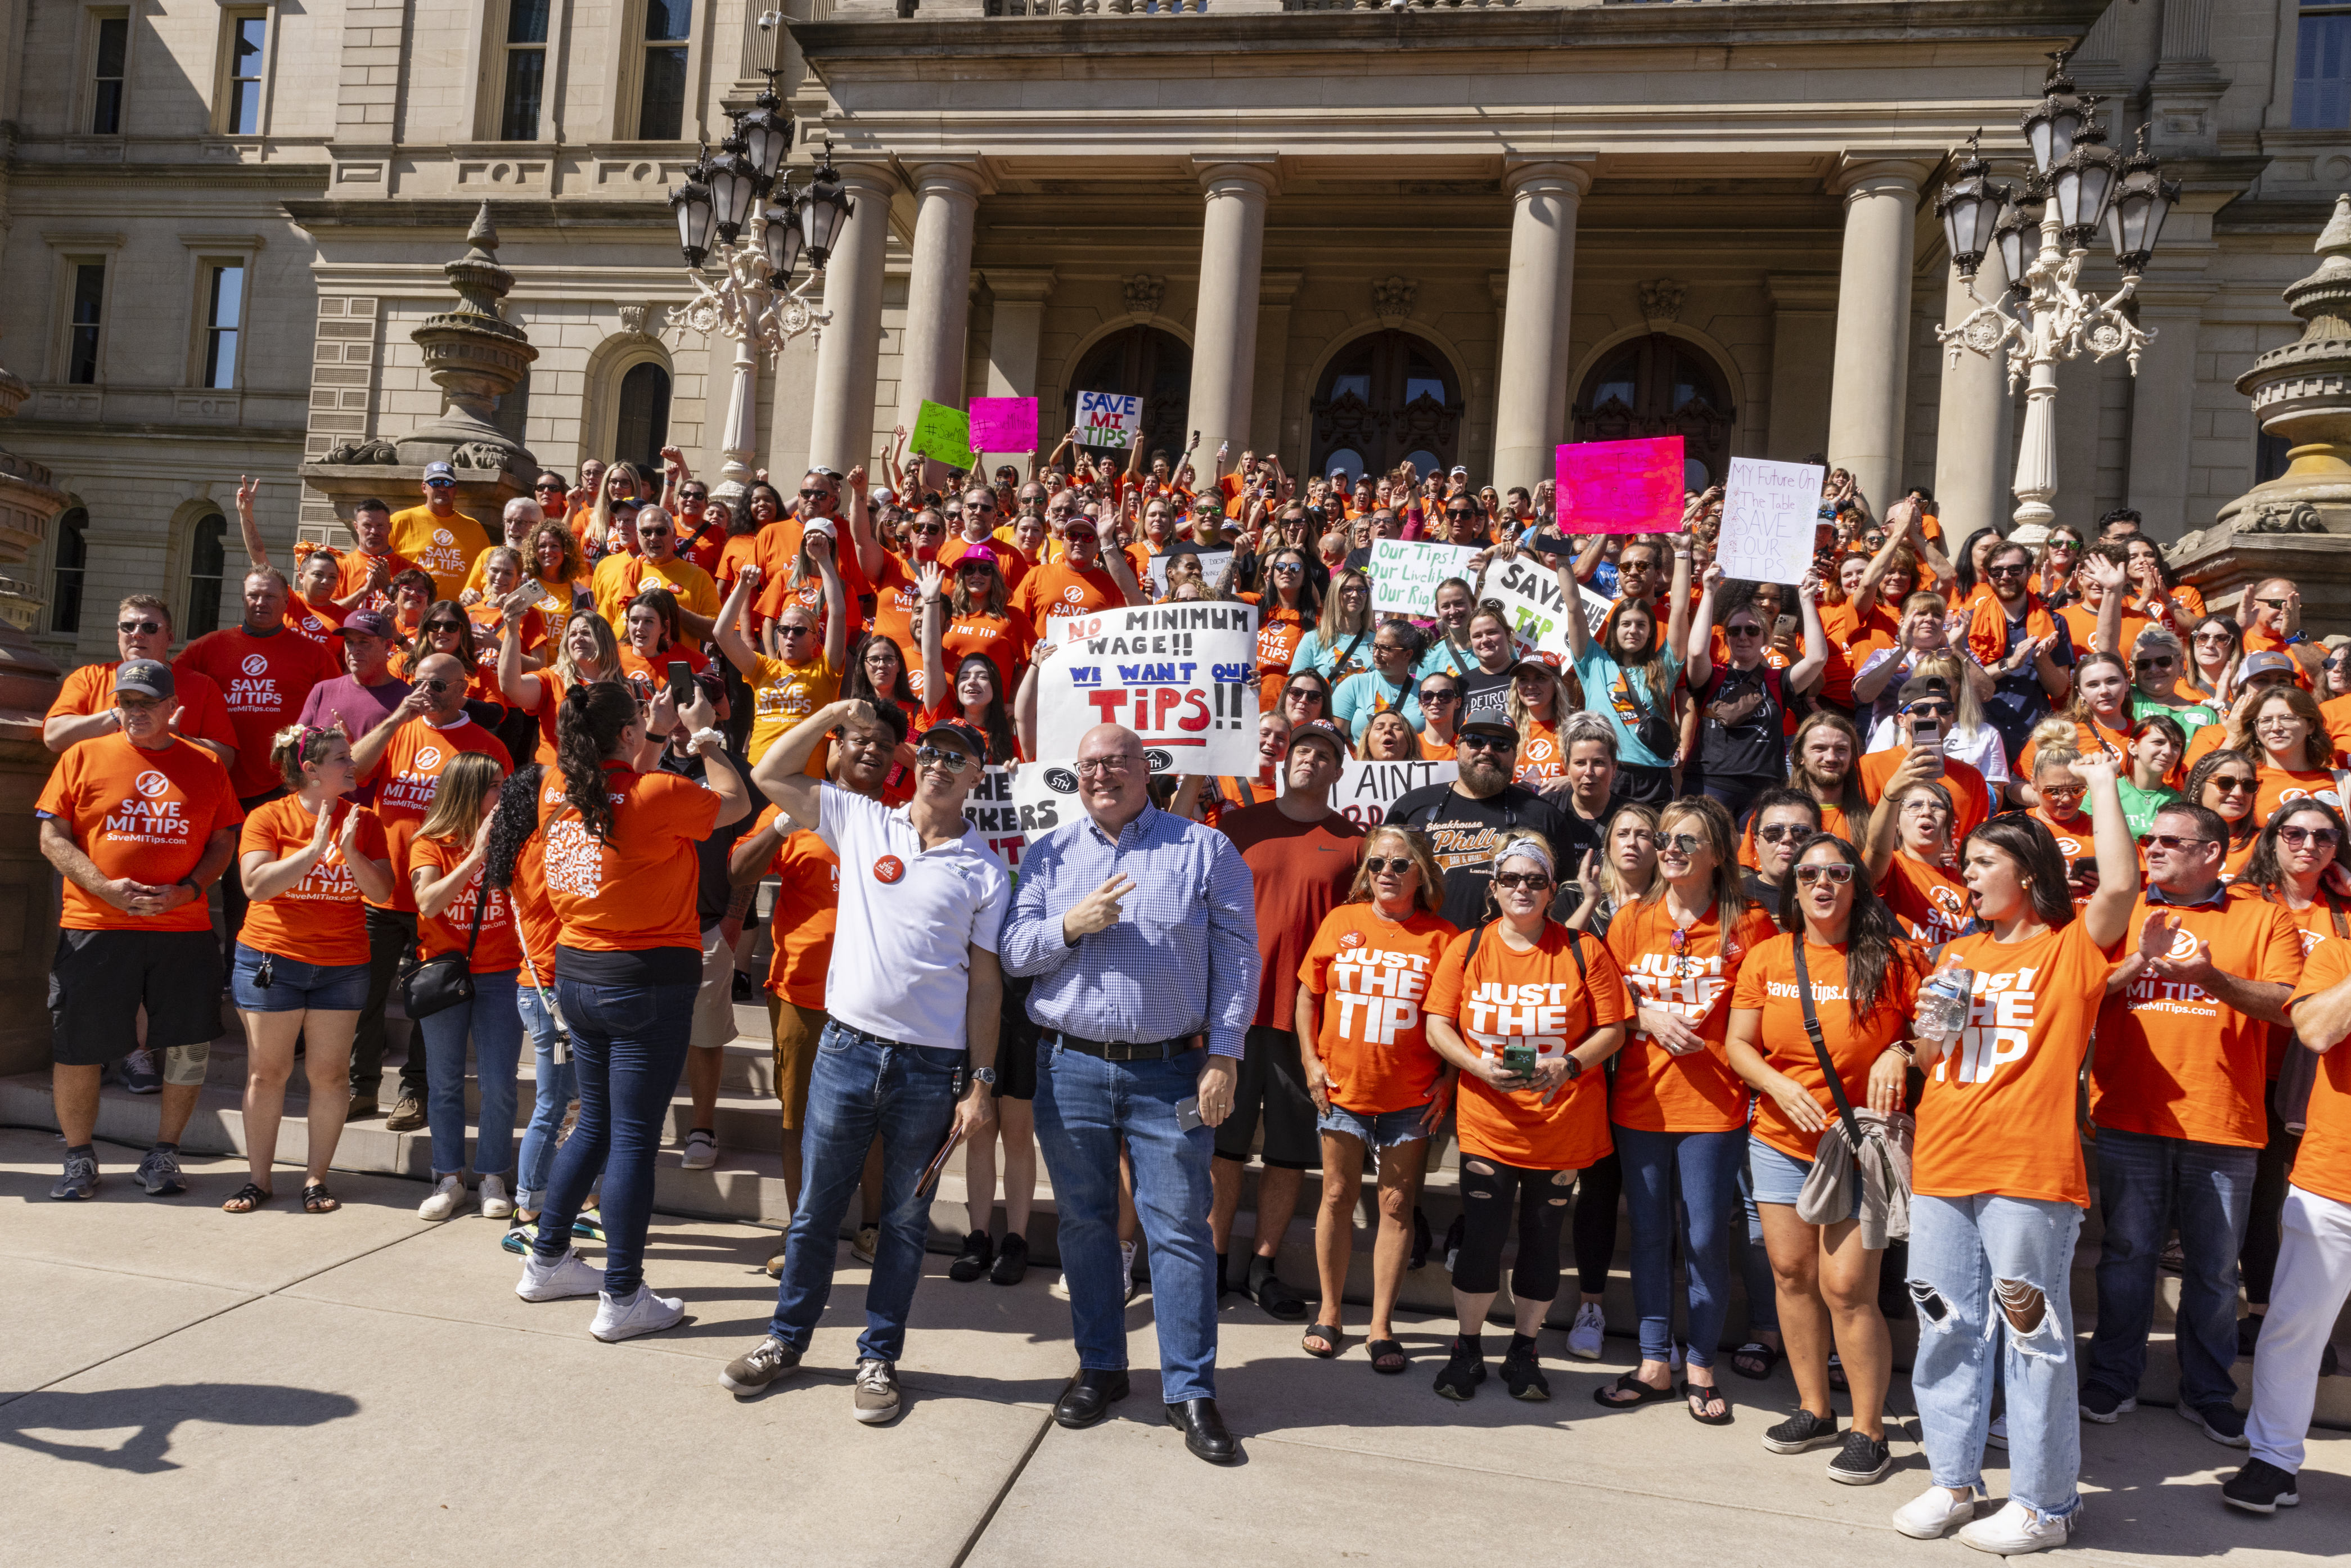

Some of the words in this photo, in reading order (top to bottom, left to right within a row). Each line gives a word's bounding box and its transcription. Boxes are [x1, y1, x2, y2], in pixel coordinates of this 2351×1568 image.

[1082, 392, 1136, 415] SAVE
[1090, 412, 1123, 429] MI
[1084, 426, 1129, 448] TIPS
[1758, 466, 1795, 488] Future
[1740, 491, 1765, 509] The
[1769, 493, 1795, 510] Table
[1735, 507, 1792, 538] SAVE
[425, 546, 461, 561] SAVE
[1379, 542, 1409, 560] Our
[1413, 544, 1458, 568] Tips!
[1744, 536, 1781, 556] OUR
[418, 557, 434, 569] MI
[438, 558, 466, 572] TIPS
[1367, 561, 1399, 580] Our
[1731, 555, 1786, 580] TIPS
[1379, 583, 1406, 602] Our
[1501, 564, 1565, 614] SAVE
[1053, 602, 1089, 616] SAVE
[1069, 618, 1101, 641] NO
[1126, 609, 1249, 632] MINIMUM
[1087, 633, 1193, 656] WAGE!!
[1261, 643, 1290, 661] TIPS
[1069, 666, 1101, 682] WE
[1117, 663, 1197, 681] WANT
[1211, 663, 1253, 682] OUR
[231, 679, 276, 692] SAVE
[759, 684, 804, 702] SAVE
[246, 692, 282, 704] TIPS
[780, 699, 812, 714] TIPS
[383, 783, 403, 797] MI
[1050, 776, 1070, 791] STH
[1354, 761, 1438, 802] AIN'T
[120, 799, 181, 817] SAVE
[106, 815, 134, 832] MI
[142, 818, 190, 835] TIPS
[1425, 819, 1483, 832] Steakhouse
[106, 833, 187, 845] SaveMITips.com
[882, 862, 894, 871] SAVE
[1449, 855, 1461, 865] BAR
[1467, 854, 1483, 863] GRILL
[310, 864, 353, 881] AVE
[443, 905, 470, 921] MI
[1911, 922, 1940, 944] MI
[1336, 947, 1430, 972] JUST
[1629, 953, 1728, 979] JUST
[1334, 963, 1426, 1001] THE
[1971, 966, 2039, 995] UST
[2125, 981, 2155, 999] MI
[1471, 982, 1567, 1007] JUST
[1335, 990, 1418, 1045] TIP
[1967, 990, 2035, 1028] HE
[2127, 1001, 2217, 1017] SaveMITips.com
[1468, 1001, 1568, 1037] THE
